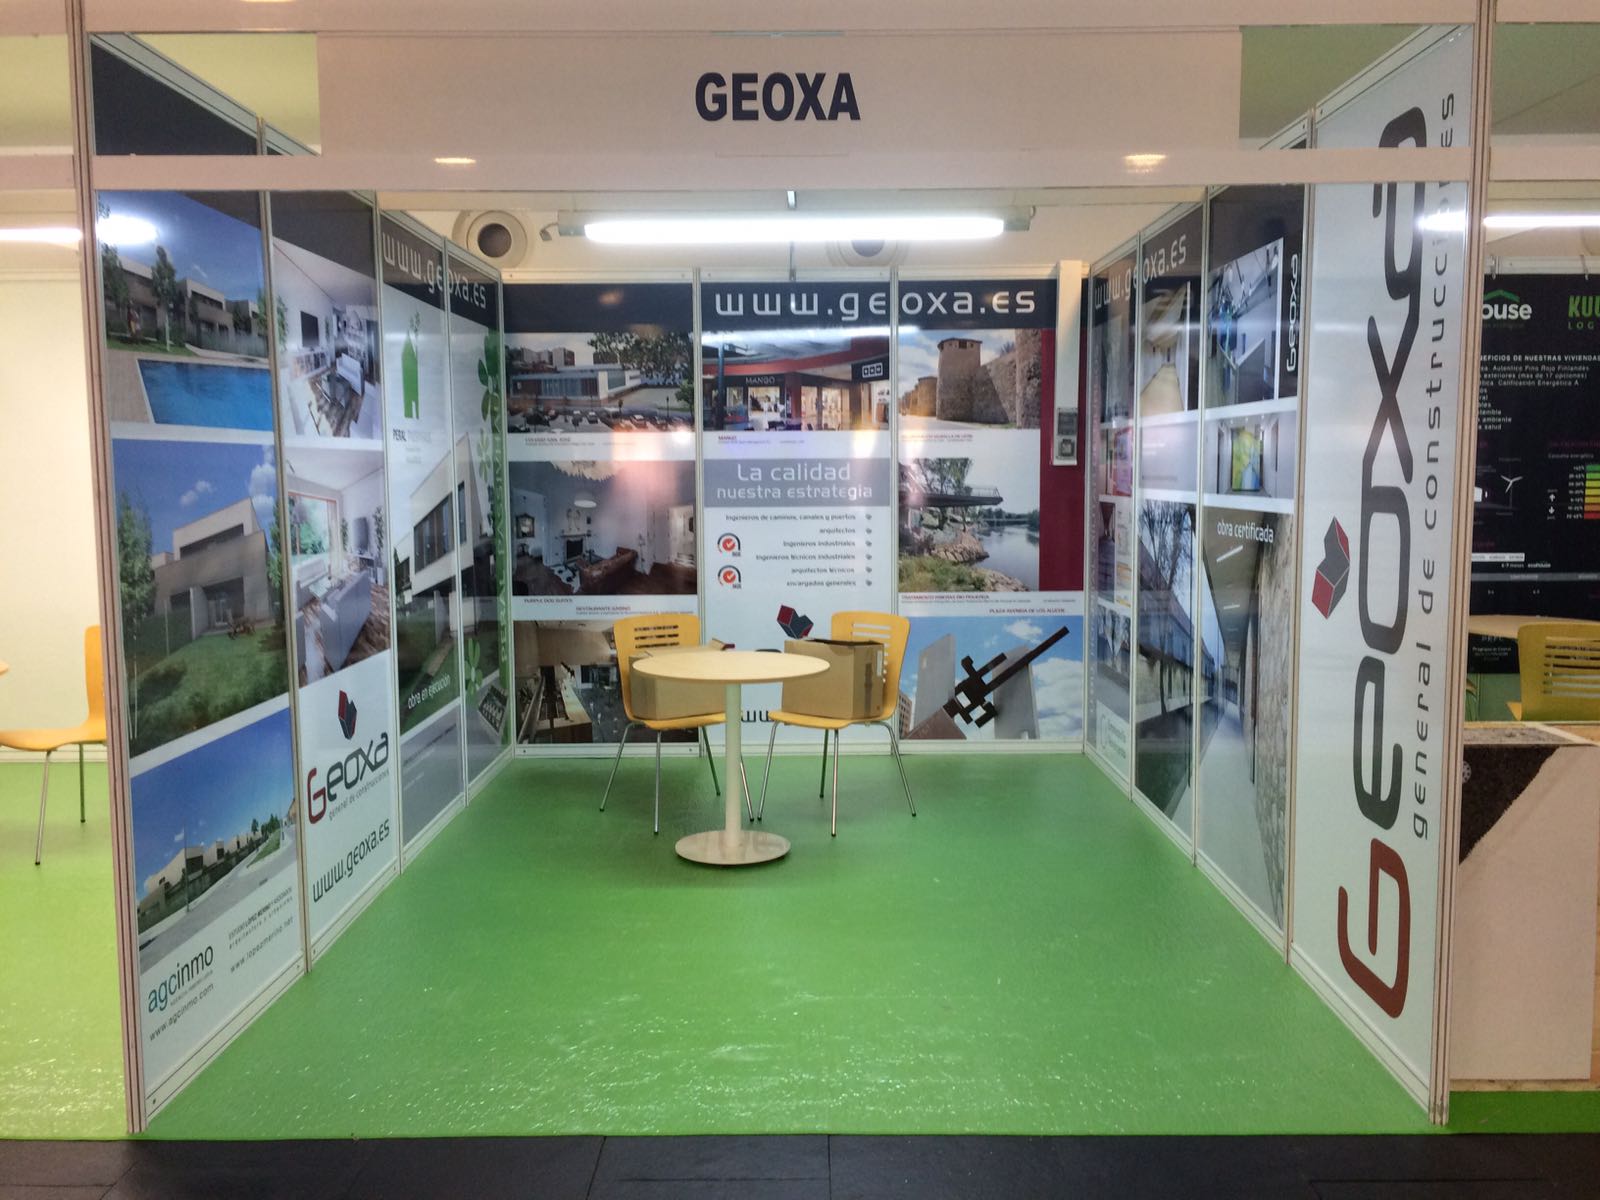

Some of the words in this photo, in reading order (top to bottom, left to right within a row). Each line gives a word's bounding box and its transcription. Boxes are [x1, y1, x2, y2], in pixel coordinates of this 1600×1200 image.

[695, 72, 861, 121] GEOXA
[1094, 234, 1188, 310] www.geoxa.es
[715, 291, 1036, 321] www.geoxa.es
[716, 484, 781, 499] nuestra
[787, 484, 873, 501] estrategia
[737, 463, 762, 481] La
[770, 463, 850, 481] calidad
[830, 514, 856, 522] puertos
[1217, 519, 1233, 537] obra
[1233, 520, 1274, 544] certificada
[1421, 557, 1435, 615] de
[1412, 641, 1432, 840] general
[307, 731, 389, 825] Geoxa
[312, 818, 390, 903] www.geoxa.es
[148, 945, 214, 1013] agcinmo
[149, 983, 214, 1041] www.agcinmo.com
